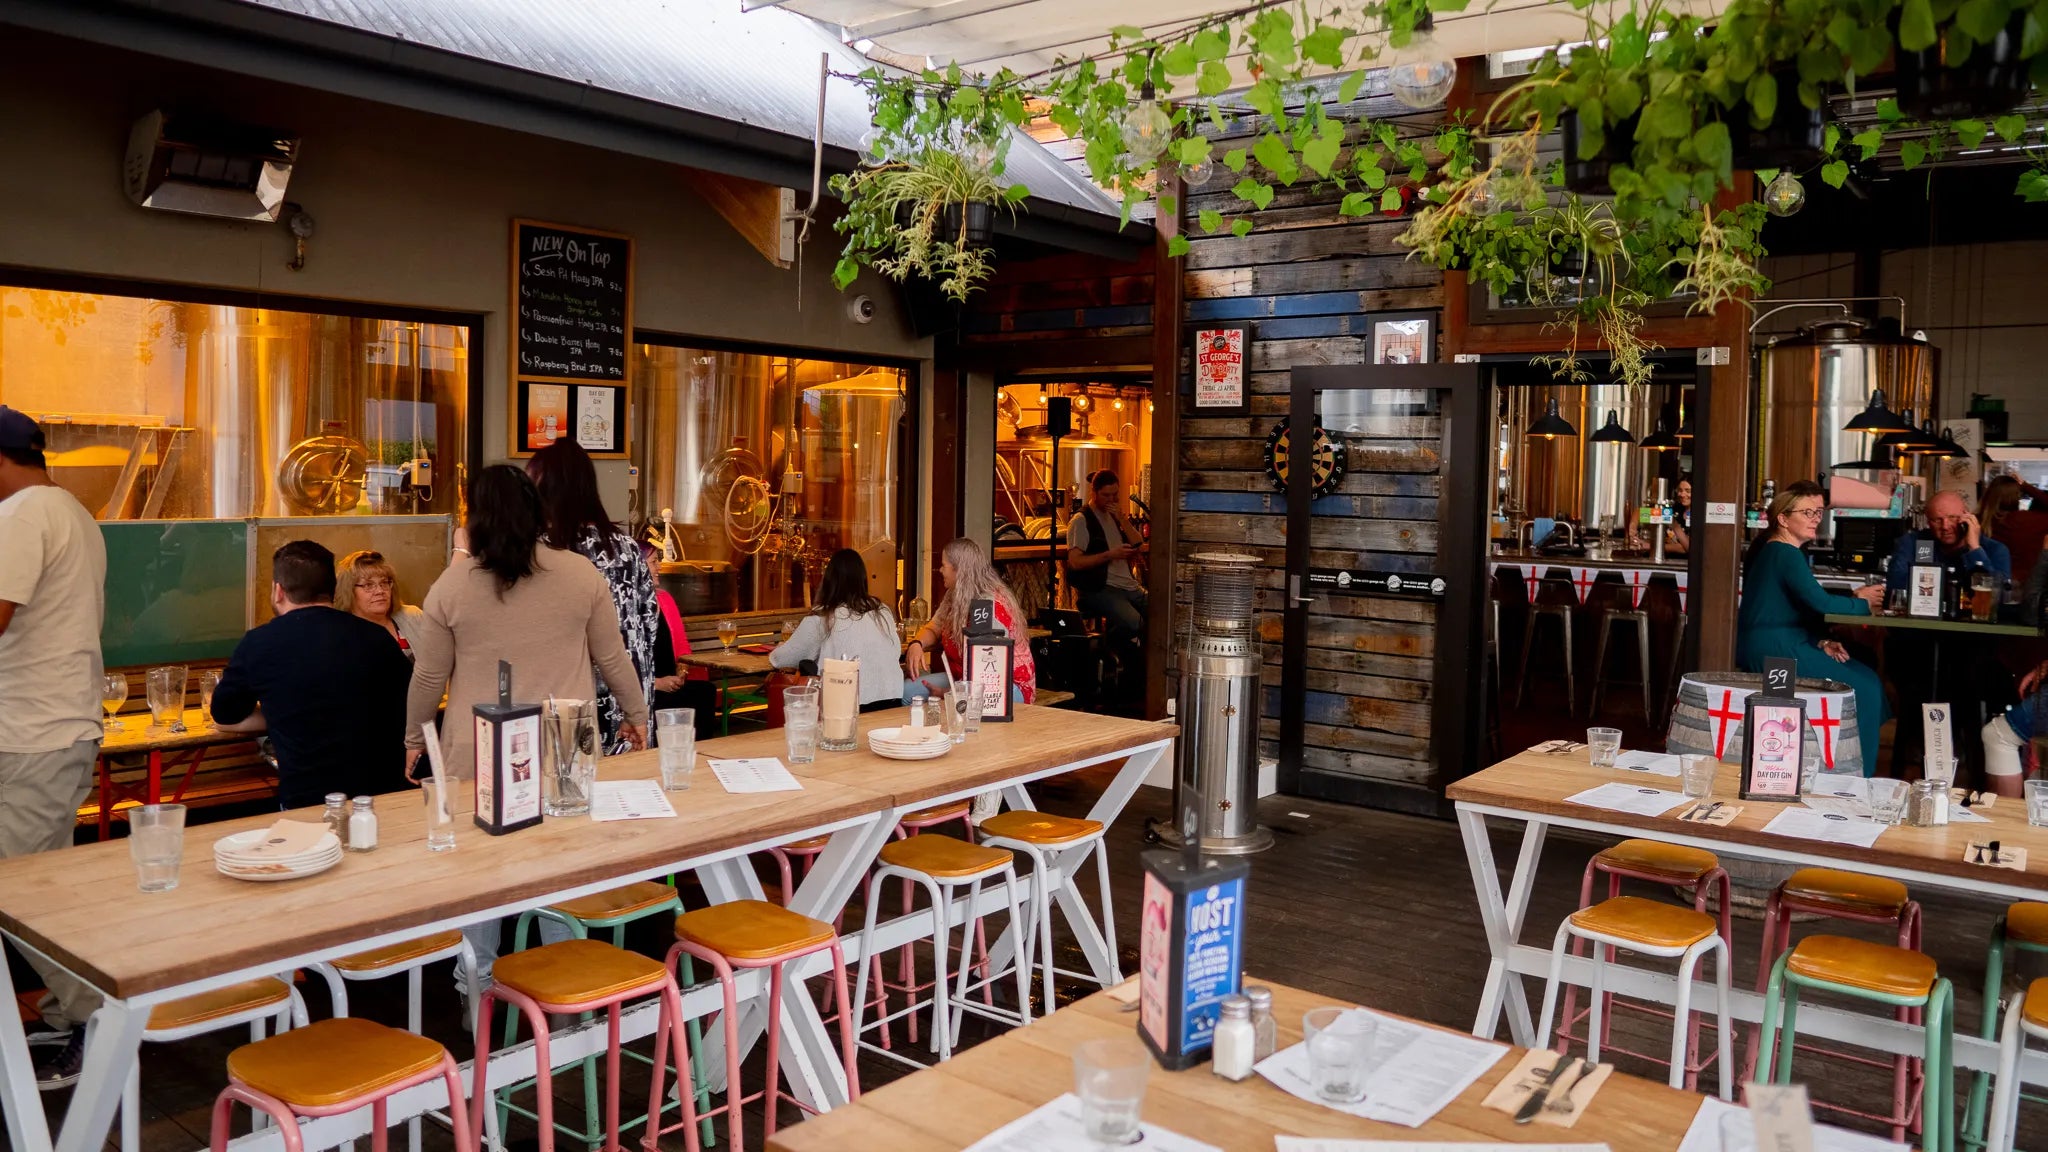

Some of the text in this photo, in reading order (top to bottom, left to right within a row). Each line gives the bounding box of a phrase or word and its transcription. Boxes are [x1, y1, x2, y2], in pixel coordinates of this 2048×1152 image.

[532, 236, 564, 252] NEW
[566, 240, 611, 268] On Tap
[533, 264, 556, 279] Sesh
[591, 275, 604, 287] IPA
[534, 331, 559, 345] Double
[1200, 352, 1240, 363] ST GEORGE'S
[588, 363, 604, 374] IPA
[973, 607, 989, 621] 56
[1768, 668, 1788, 685] 59
[1770, 771, 1781, 779] OFF
[1781, 771, 1792, 779] GIN
[1190, 896, 1235, 934] HOST
